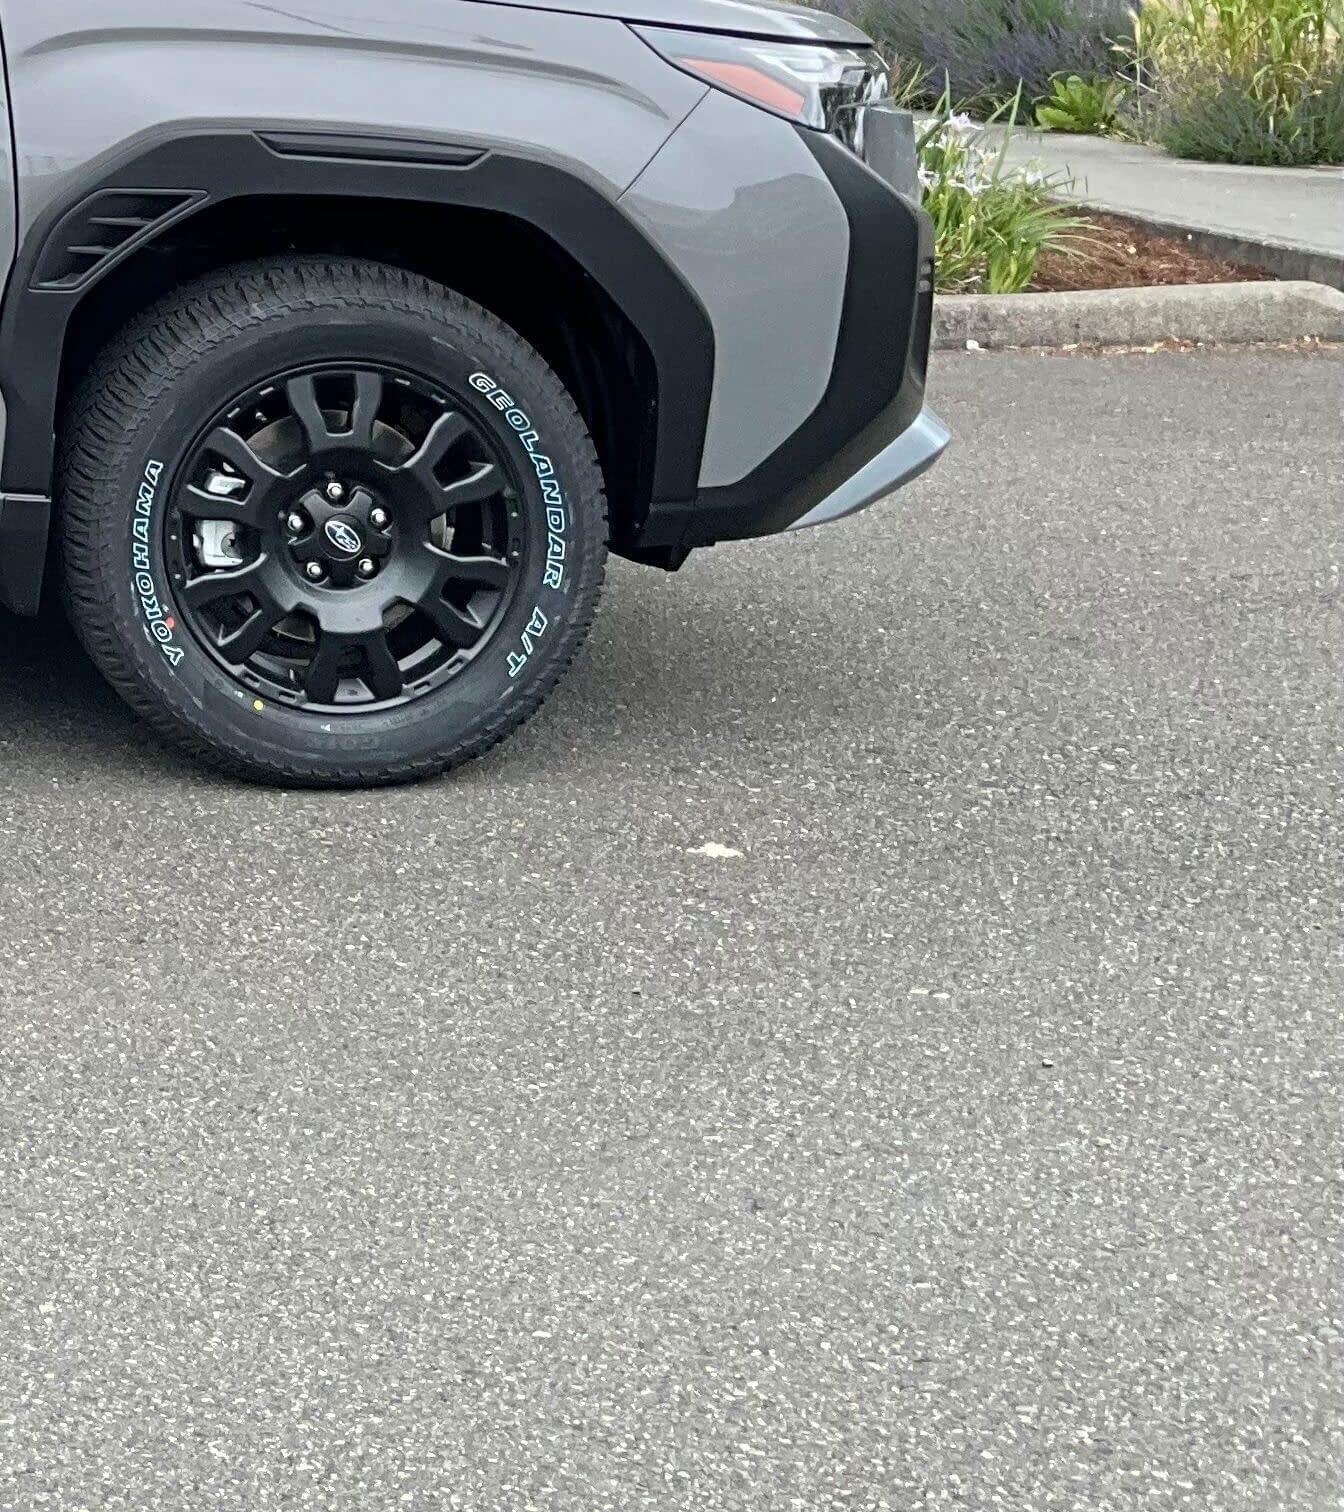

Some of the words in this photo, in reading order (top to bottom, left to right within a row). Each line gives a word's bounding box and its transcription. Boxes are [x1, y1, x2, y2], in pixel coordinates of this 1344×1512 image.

[132, 459, 185, 666] YOKOHAMA
[469, 372, 567, 589] GEOLANDAR
[505, 606, 549, 677] A/T
